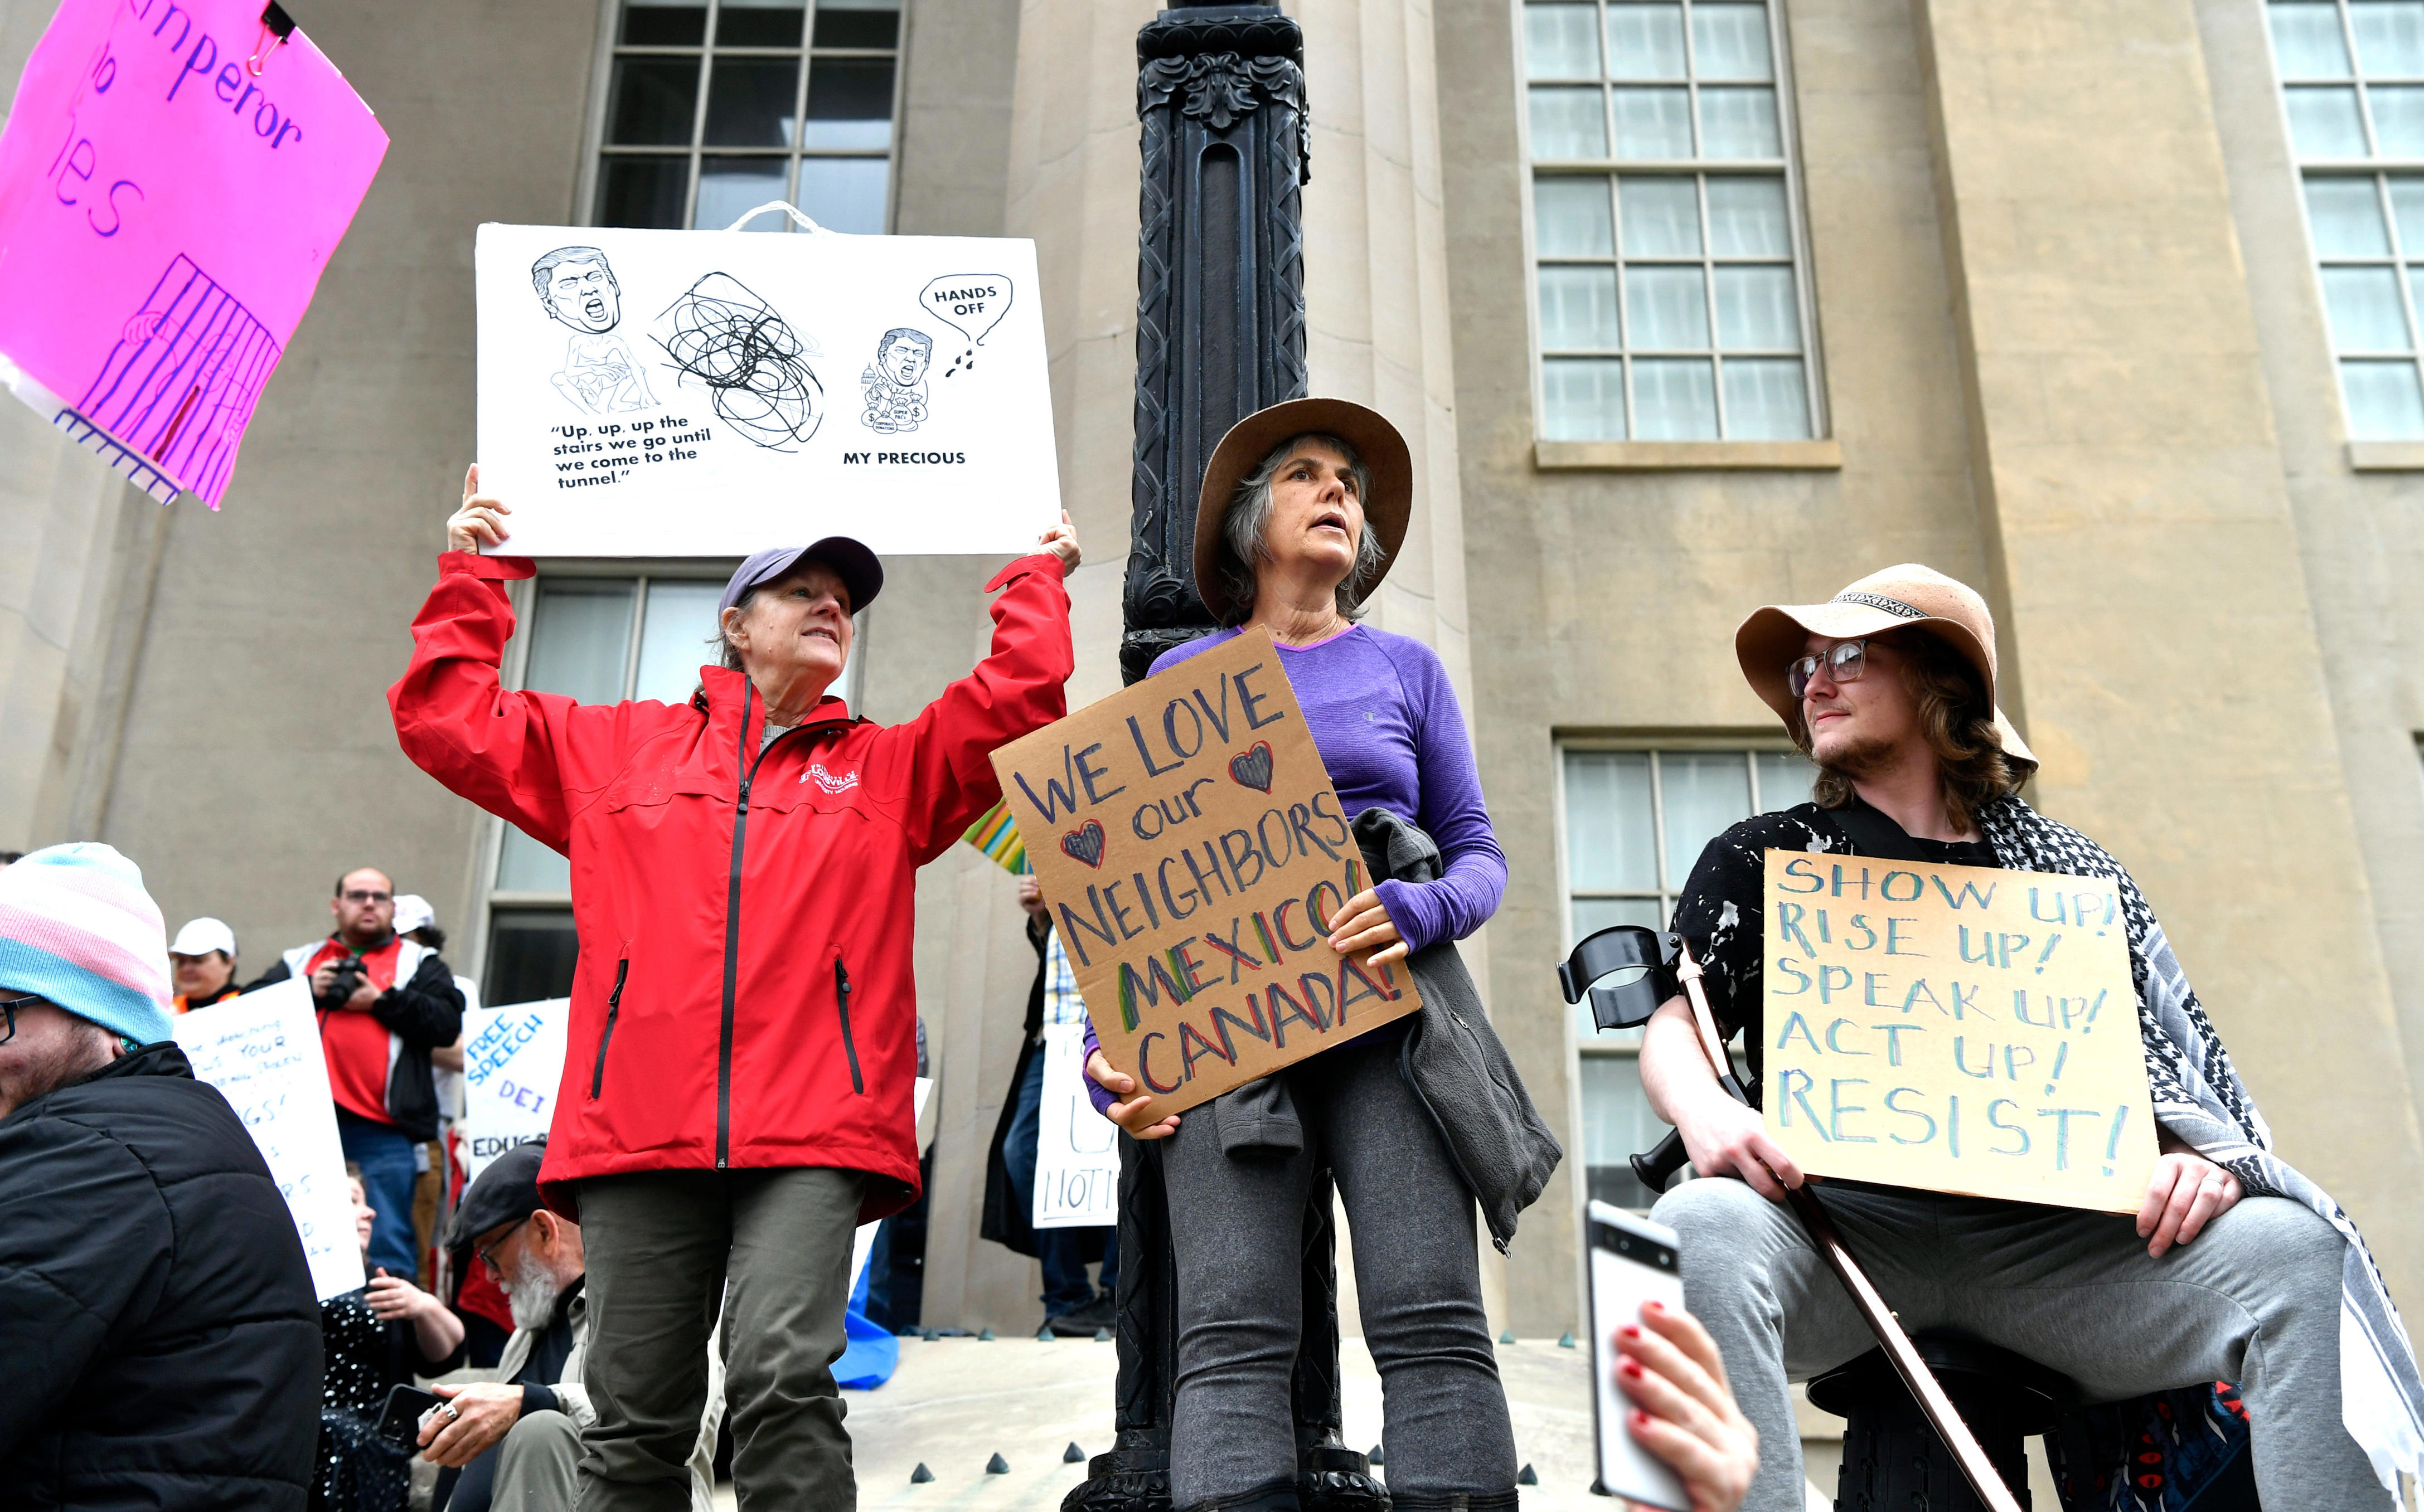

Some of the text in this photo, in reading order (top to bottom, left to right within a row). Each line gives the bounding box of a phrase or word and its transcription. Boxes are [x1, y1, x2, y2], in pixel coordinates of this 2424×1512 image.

[934, 286, 997, 302] HANDS
[954, 303, 985, 315] OFF
[554, 428, 711, 455] stairs we go until
[631, 421, 654, 434] up
[660, 415, 689, 428] the
[555, 448, 697, 471] we come to the
[843, 452, 966, 464] MY PRECIOUS
[1014, 663, 1285, 824] WE LOVE
[811, 766, 859, 786] LOUISVILLE
[1132, 778, 1215, 840] our
[1058, 791, 1350, 967] NEIGHBORS
[1777, 858, 2117, 937] SHOW UP!
[1778, 901, 2062, 975] RISE UP!
[1139, 942, 1403, 1095] CANADA!
[1772, 957, 2108, 1034] SPEAK UP!
[466, 1013, 514, 1060] FREE
[468, 1014, 544, 1086] SPEECH
[1777, 1011, 2068, 1097] ACT UP!
[498, 1080, 546, 1114] DEI
[1778, 1068, 2130, 1177] RESIST!
